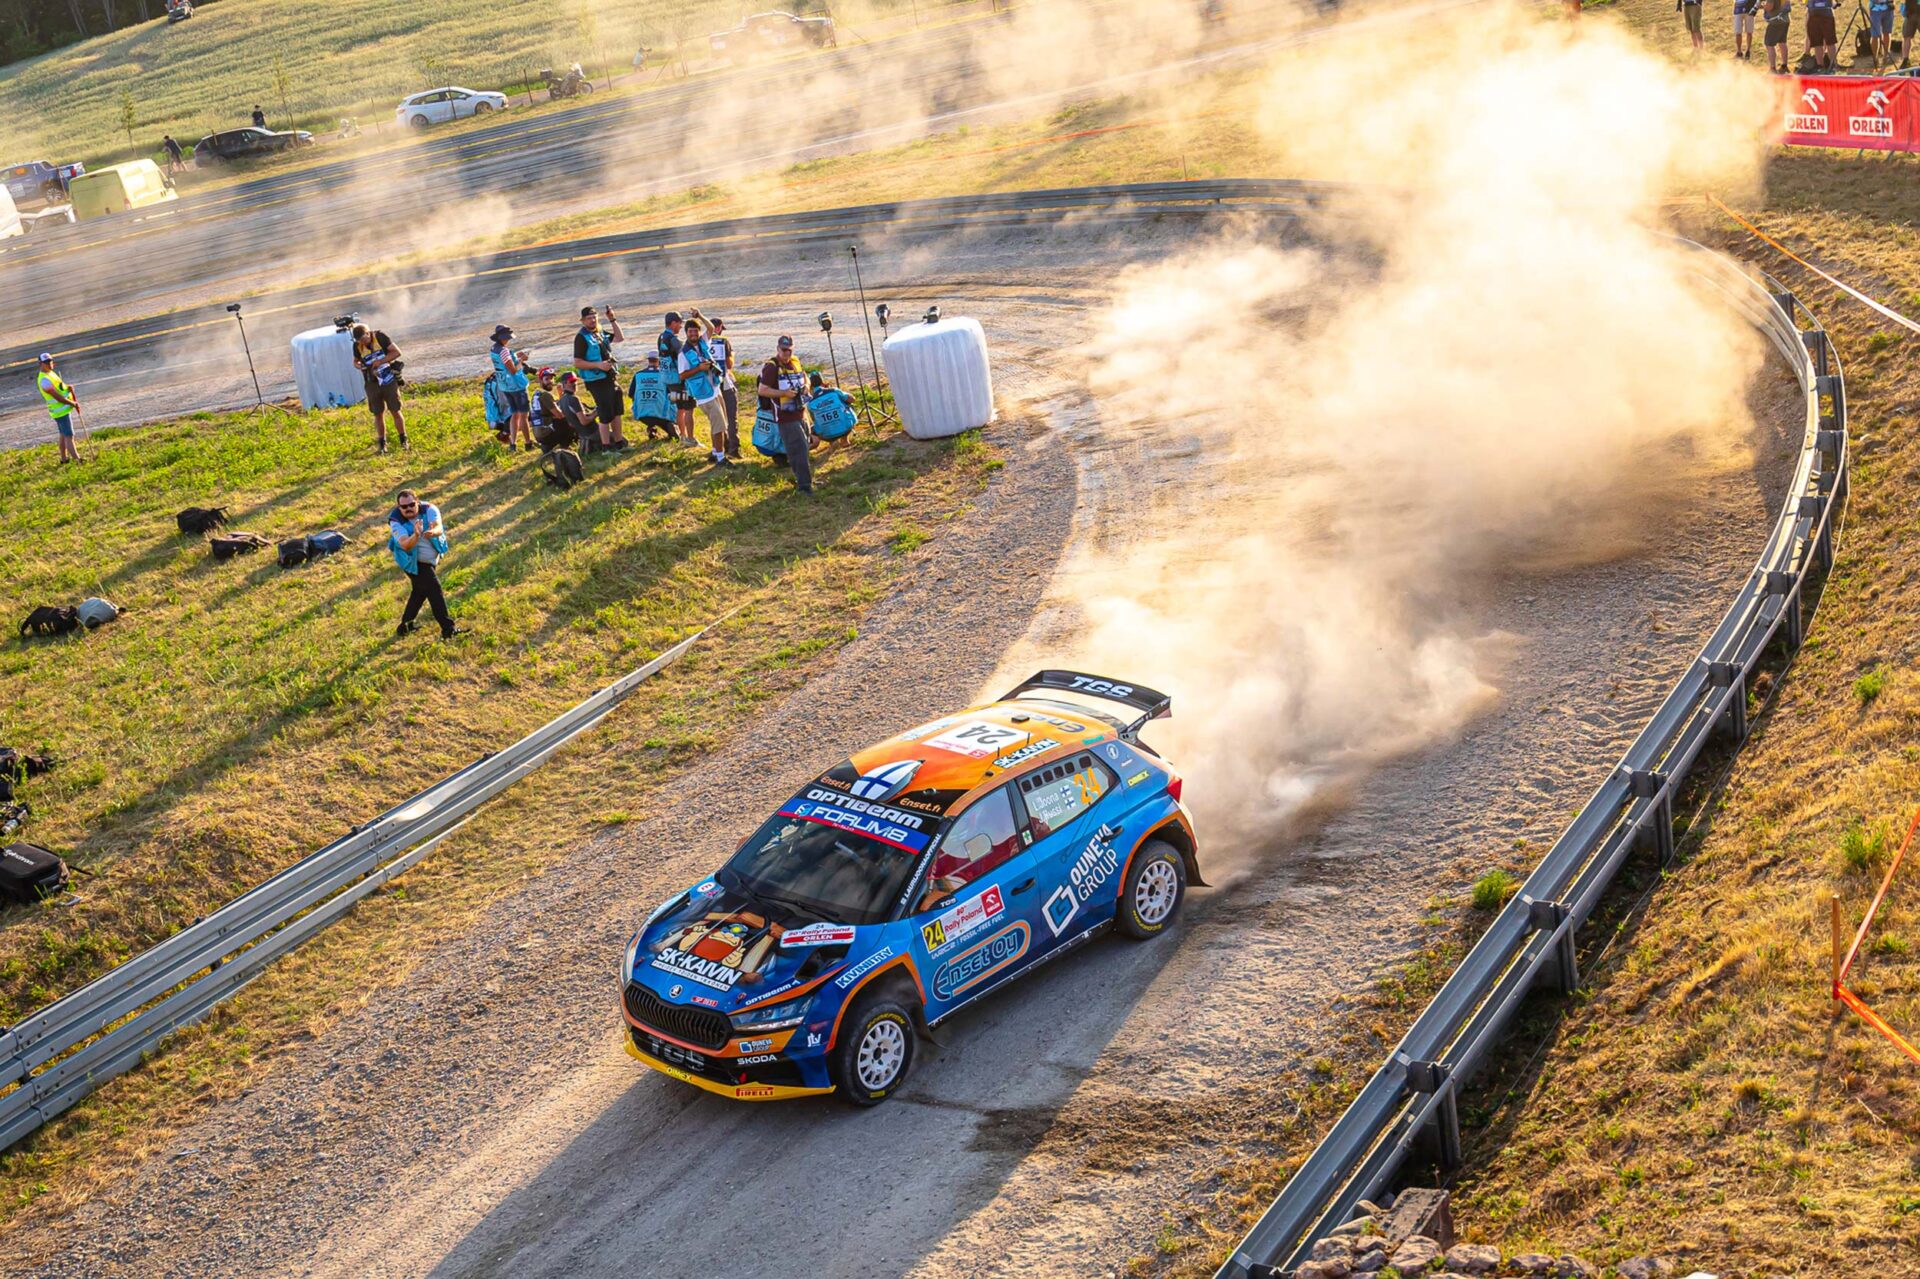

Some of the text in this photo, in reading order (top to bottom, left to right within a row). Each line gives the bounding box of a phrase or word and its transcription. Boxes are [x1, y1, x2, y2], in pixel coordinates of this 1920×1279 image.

[1786, 116, 1825, 131] ORLEN
[1852, 119, 1890, 133] ORLEN
[641, 390, 658, 399] 192
[821, 410, 839, 422] 168
[1069, 676, 1134, 698] TGS
[956, 725, 1017, 744] 24
[1073, 767, 1101, 804] 24
[899, 797, 942, 813] Enset.fi
[811, 806, 908, 842] FORUM8
[1078, 848, 1119, 901] GROUP
[944, 904, 984, 934] Rally Poland
[991, 914, 1005, 925] FUEL
[803, 934, 833, 942] ORLEN
[924, 920, 946, 951] 24
[657, 947, 743, 985] SK-KAIVIN
[932, 932, 1018, 1001] Enset Oy
[735, 1086, 774, 1097] PIRELLI
